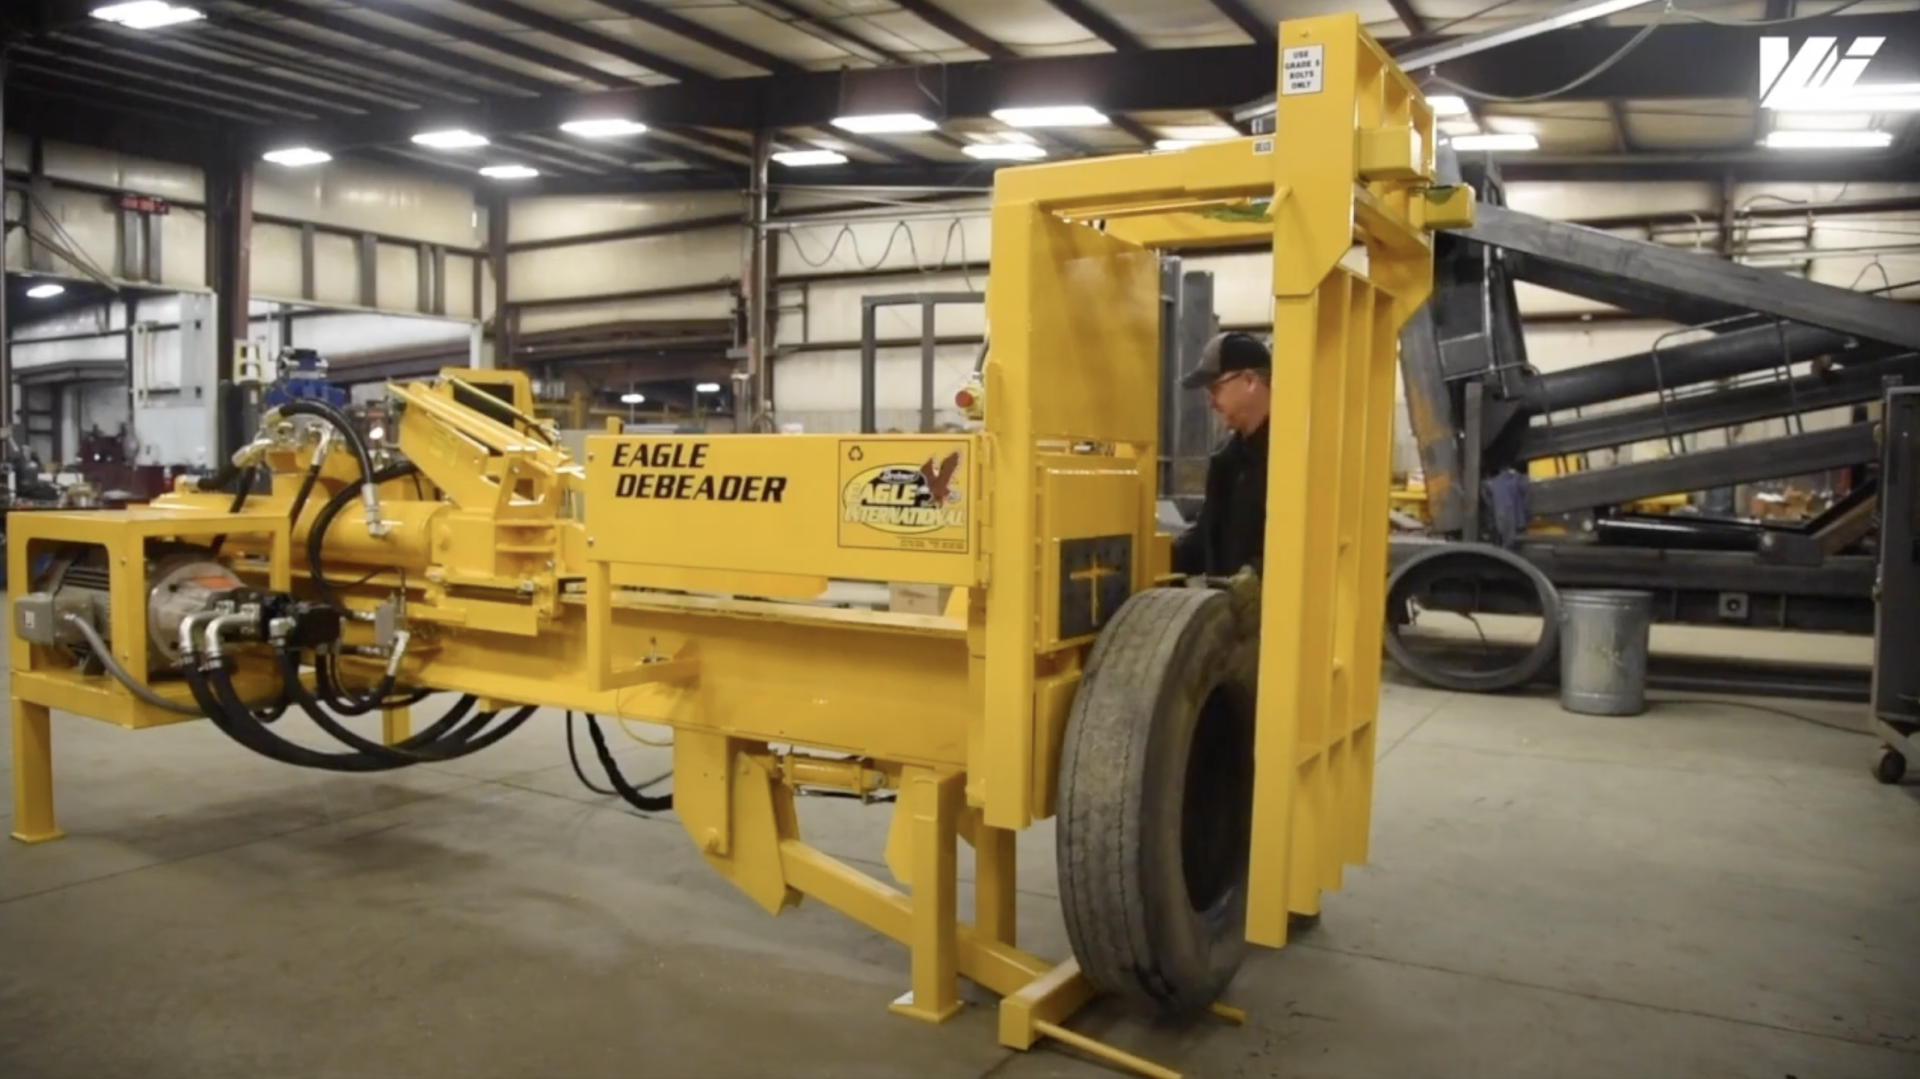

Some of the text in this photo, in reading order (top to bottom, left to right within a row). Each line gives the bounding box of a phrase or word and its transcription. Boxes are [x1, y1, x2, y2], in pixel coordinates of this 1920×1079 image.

[1293, 50, 1308, 59] USE
[1285, 60, 1311, 70] GRADE
[1290, 70, 1314, 79] BOLTS
[1291, 81, 1311, 90] ONLY
[612, 443, 709, 468] EAGLE
[615, 474, 787, 503] DEBEADER
[845, 482, 920, 506] EAGLE
[844, 506, 965, 527] INTERNATIONAL
